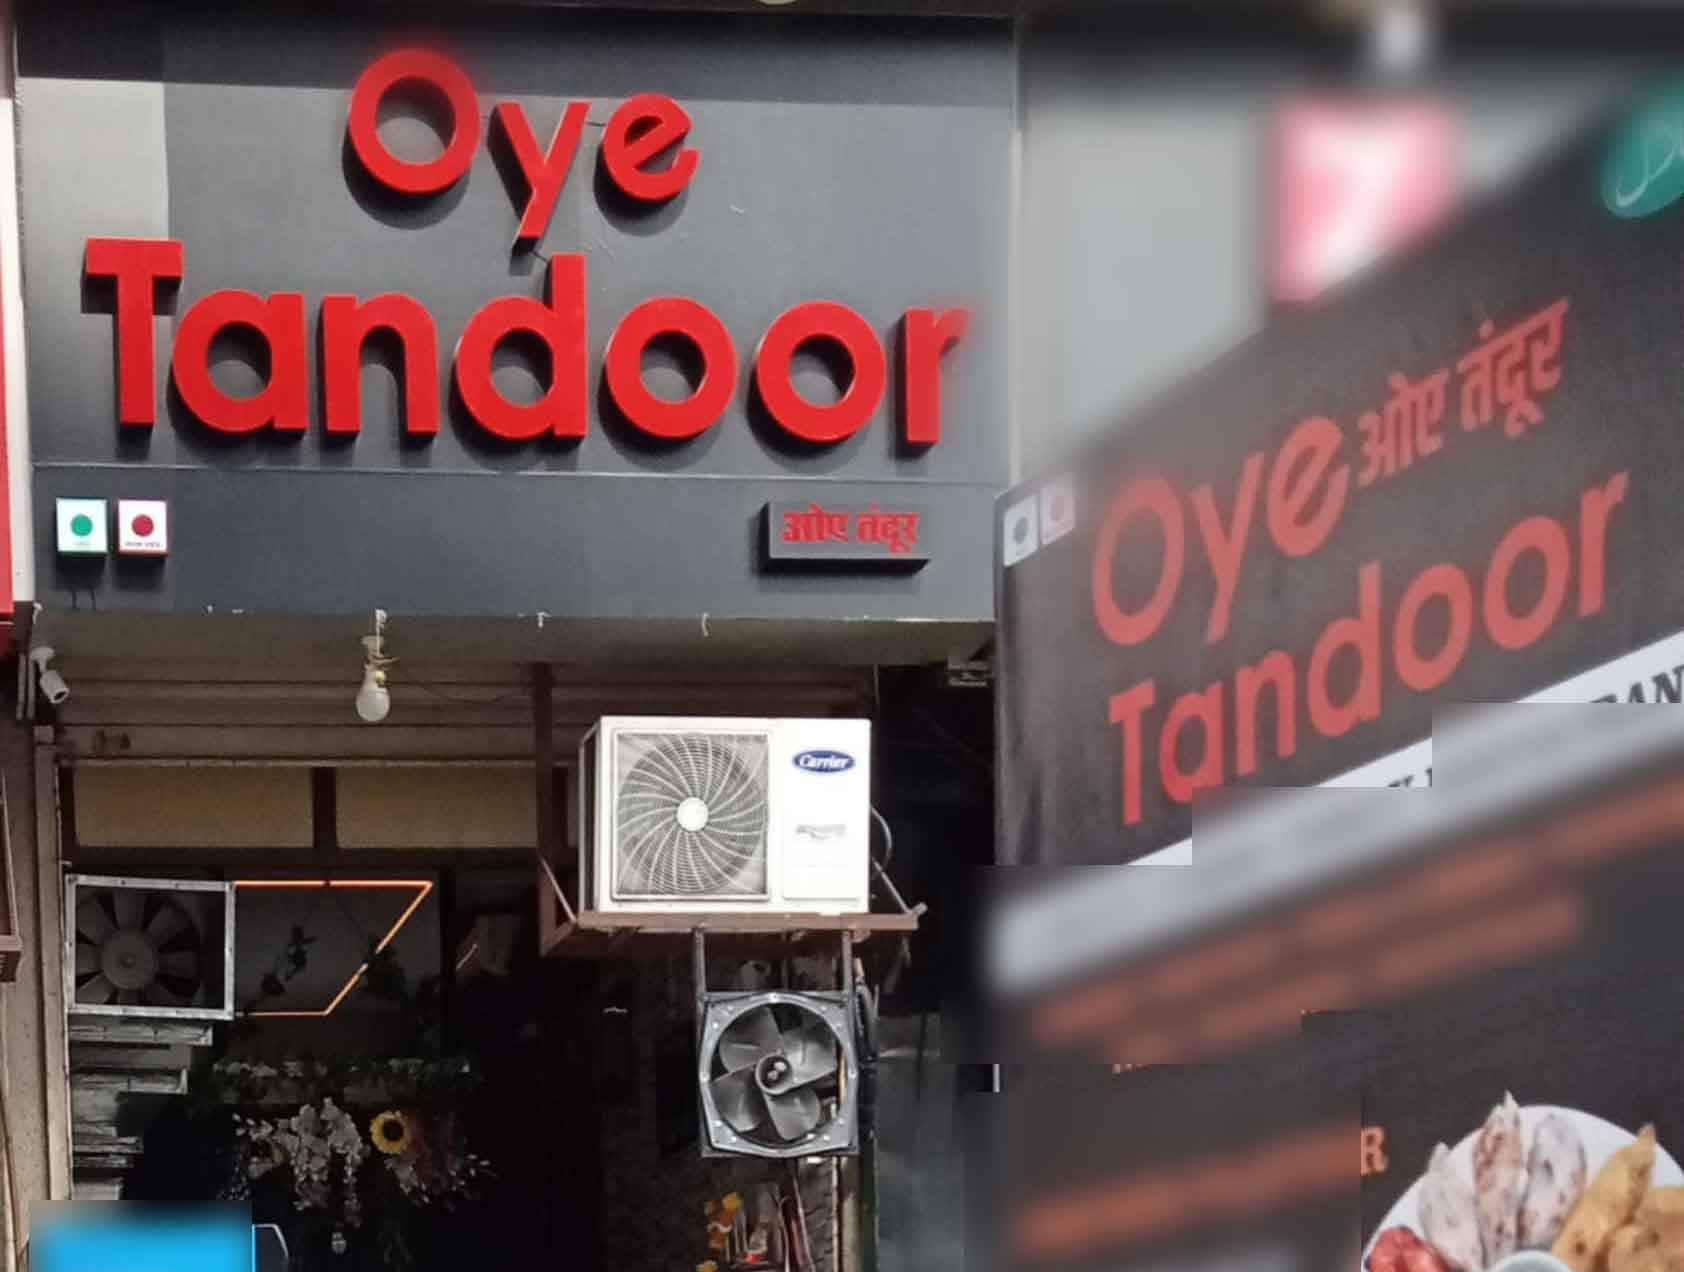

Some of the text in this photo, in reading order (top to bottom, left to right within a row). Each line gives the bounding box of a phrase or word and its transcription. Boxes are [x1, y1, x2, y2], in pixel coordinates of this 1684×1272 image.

[347, 48, 700, 248] Oye
[84, 237, 970, 447] Tandoor
[1357, 297, 1569, 489] ओए तंदूर
[1092, 416, 1350, 647] Oye
[1108, 471, 1630, 827] Tandoor
[799, 753, 850, 769] Carrier
